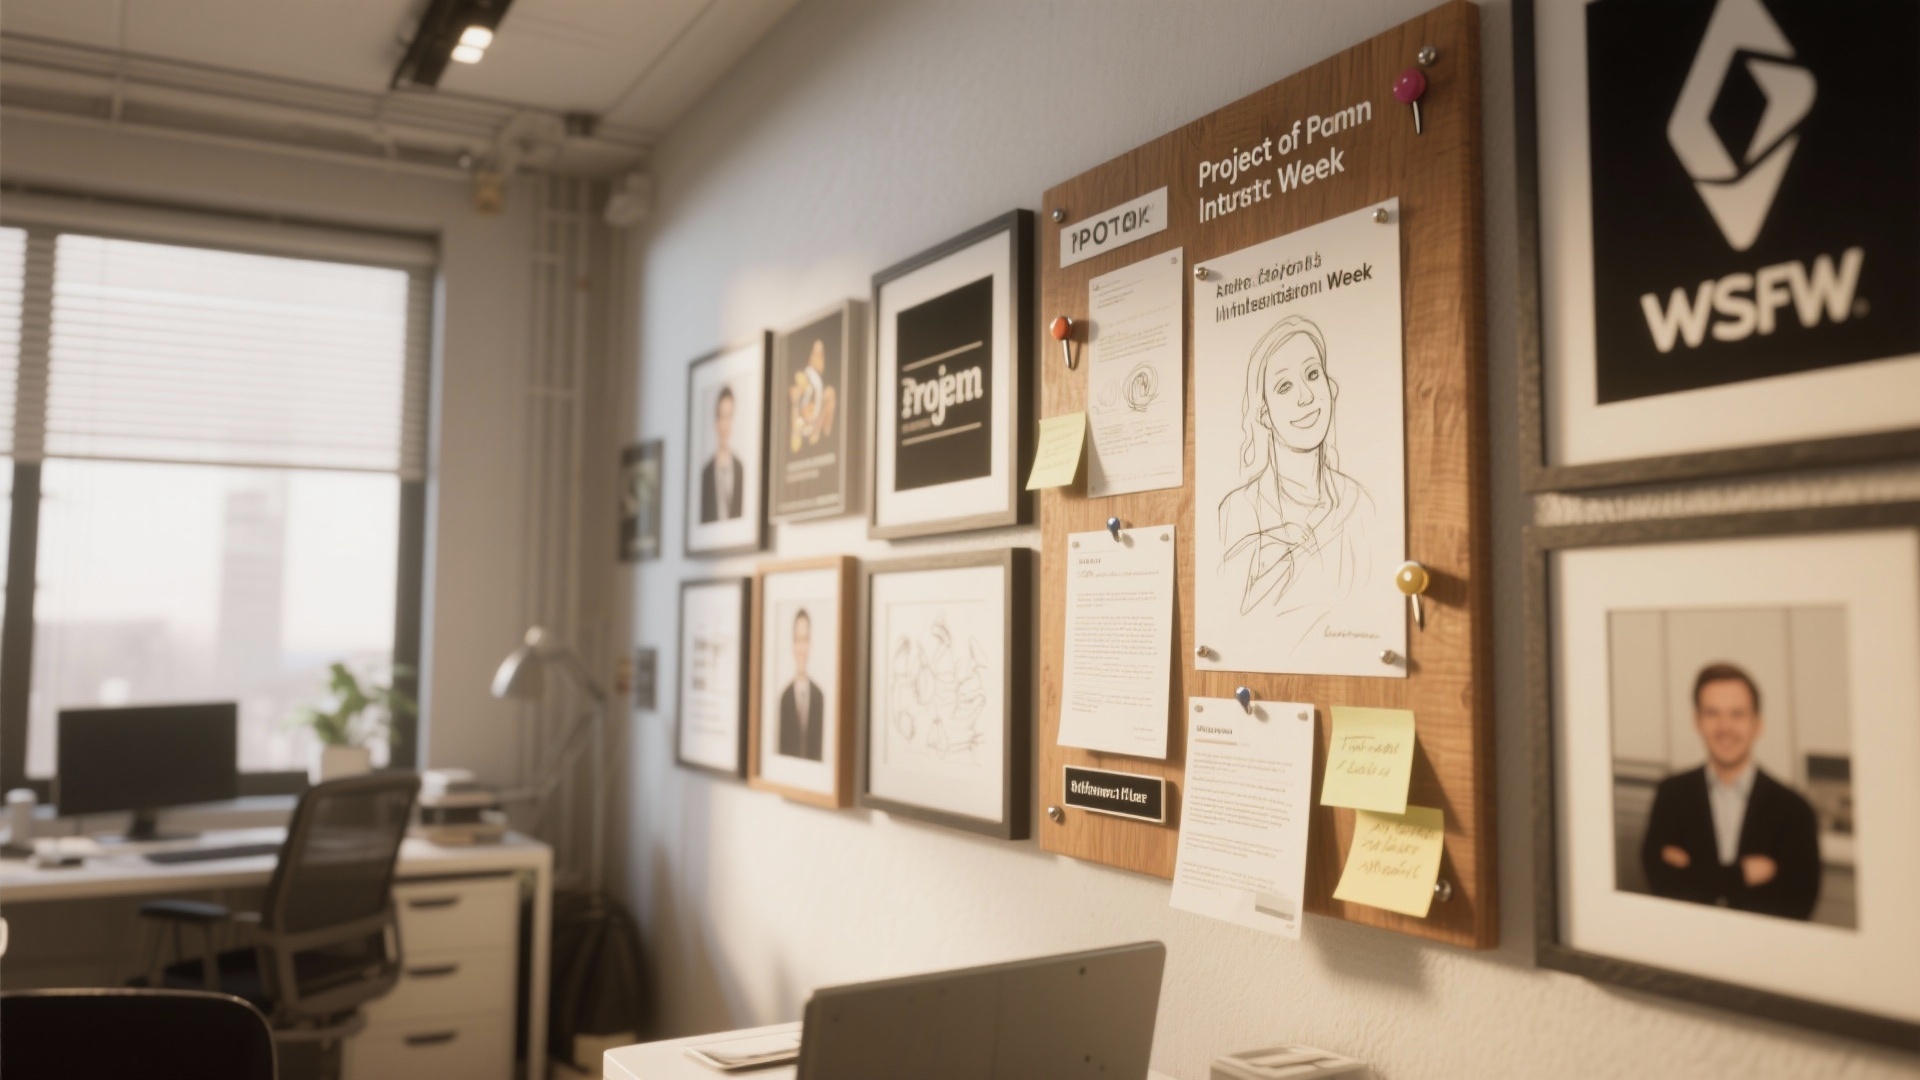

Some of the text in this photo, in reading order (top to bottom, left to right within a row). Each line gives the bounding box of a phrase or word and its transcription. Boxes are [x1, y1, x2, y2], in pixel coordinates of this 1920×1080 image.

[1199, 147, 1272, 188] Project
[1278, 119, 1301, 155] of
[1277, 147, 1345, 193] Week
[1327, 262, 1373, 291] Week
[1640, 246, 1865, 353] WSFW
